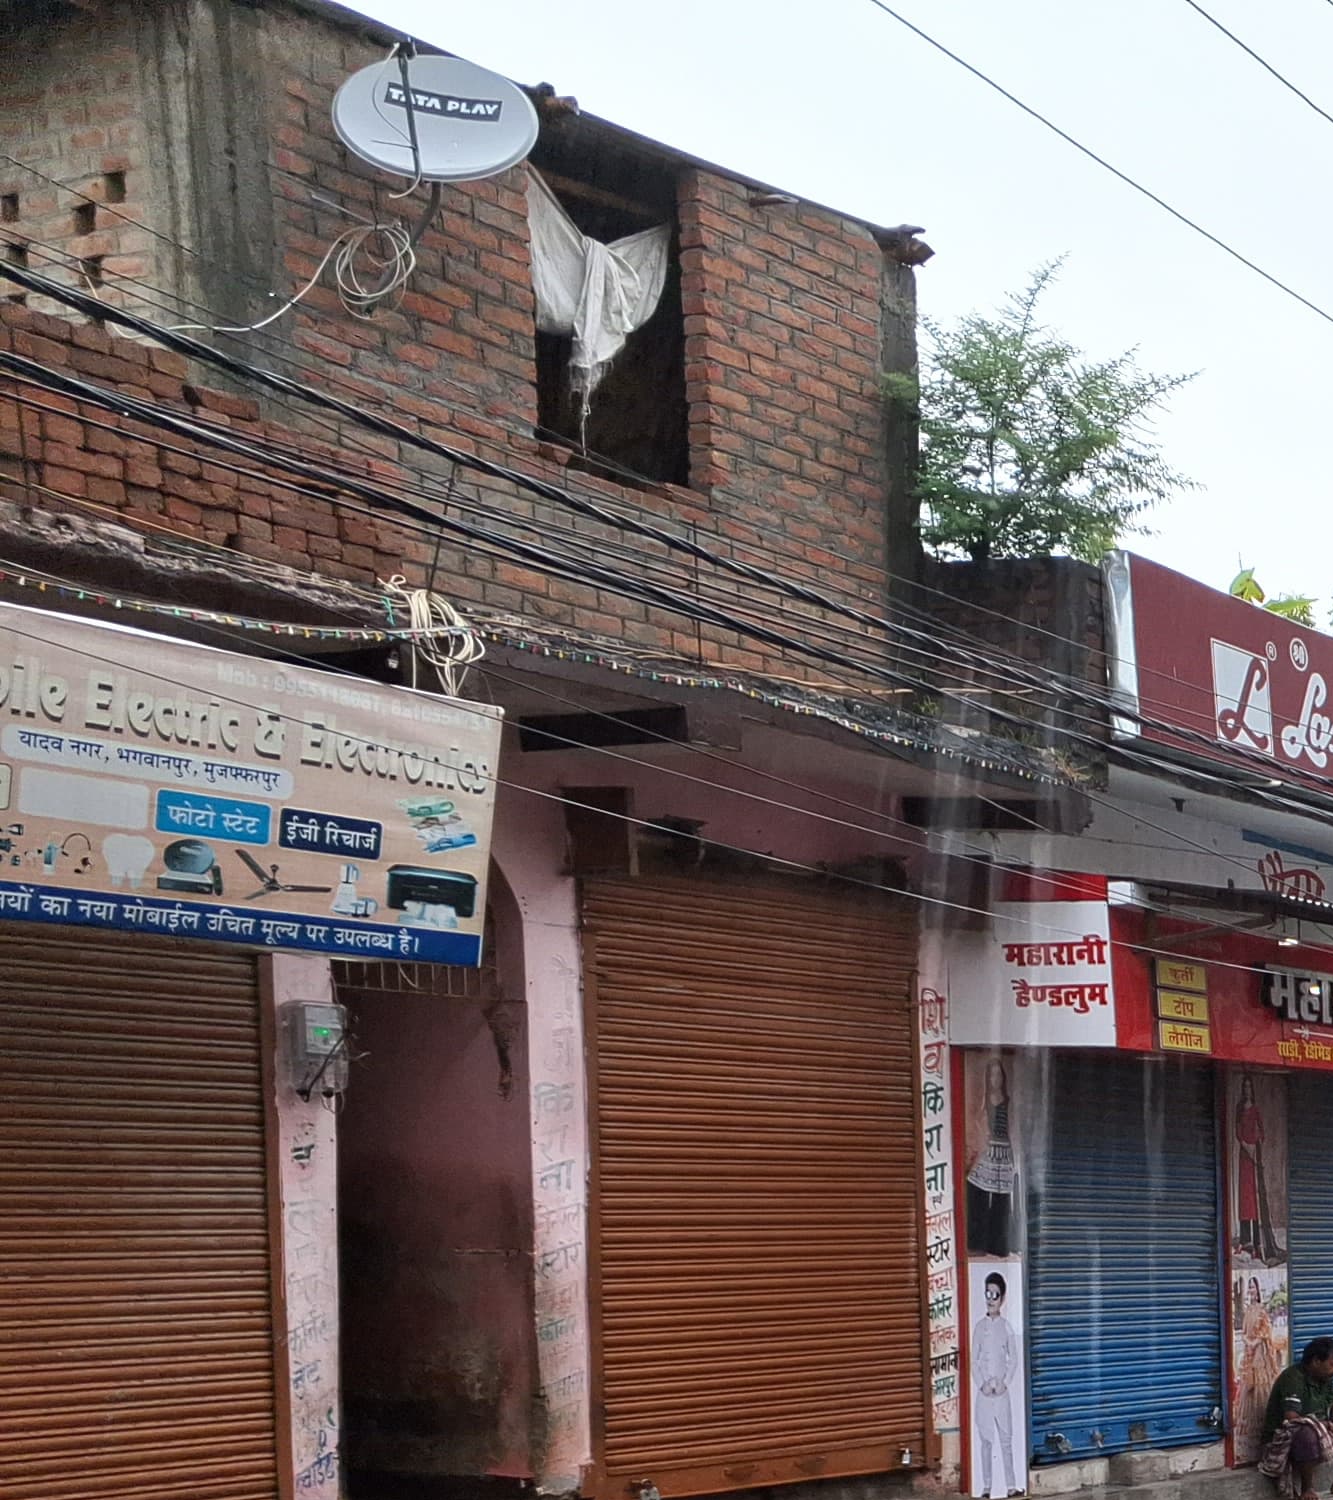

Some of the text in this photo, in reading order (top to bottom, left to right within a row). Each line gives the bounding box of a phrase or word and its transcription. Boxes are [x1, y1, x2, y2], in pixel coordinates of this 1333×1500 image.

[446, 101, 498, 115] PLAY
[85, 669, 240, 752] Electric
[254, 703, 286, 760] &
[300, 711, 489, 794] Electronics
[18, 729, 64, 753] यादव
[69, 739, 110, 763] नगर,
[117, 746, 198, 779] भगवानपुर,
[167, 800, 261, 835] फोटो स्टेट
[285, 813, 377, 853] ईजी रिचार्ज
[39, 895, 72, 917] का
[77, 899, 117, 922] नया
[123, 898, 201, 932] मोबाईल
[206, 908, 256, 936] उचित
[260, 921, 301, 945] मूल्य
[306, 925, 329, 945] पर
[333, 926, 393, 951] उपलब्ध
[398, 928, 420, 955] है।
[1002, 933, 1108, 968] महारानी
[1010, 978, 1109, 1014] हैण्डलुम
[1172, 995, 1195, 1018] टॉप
